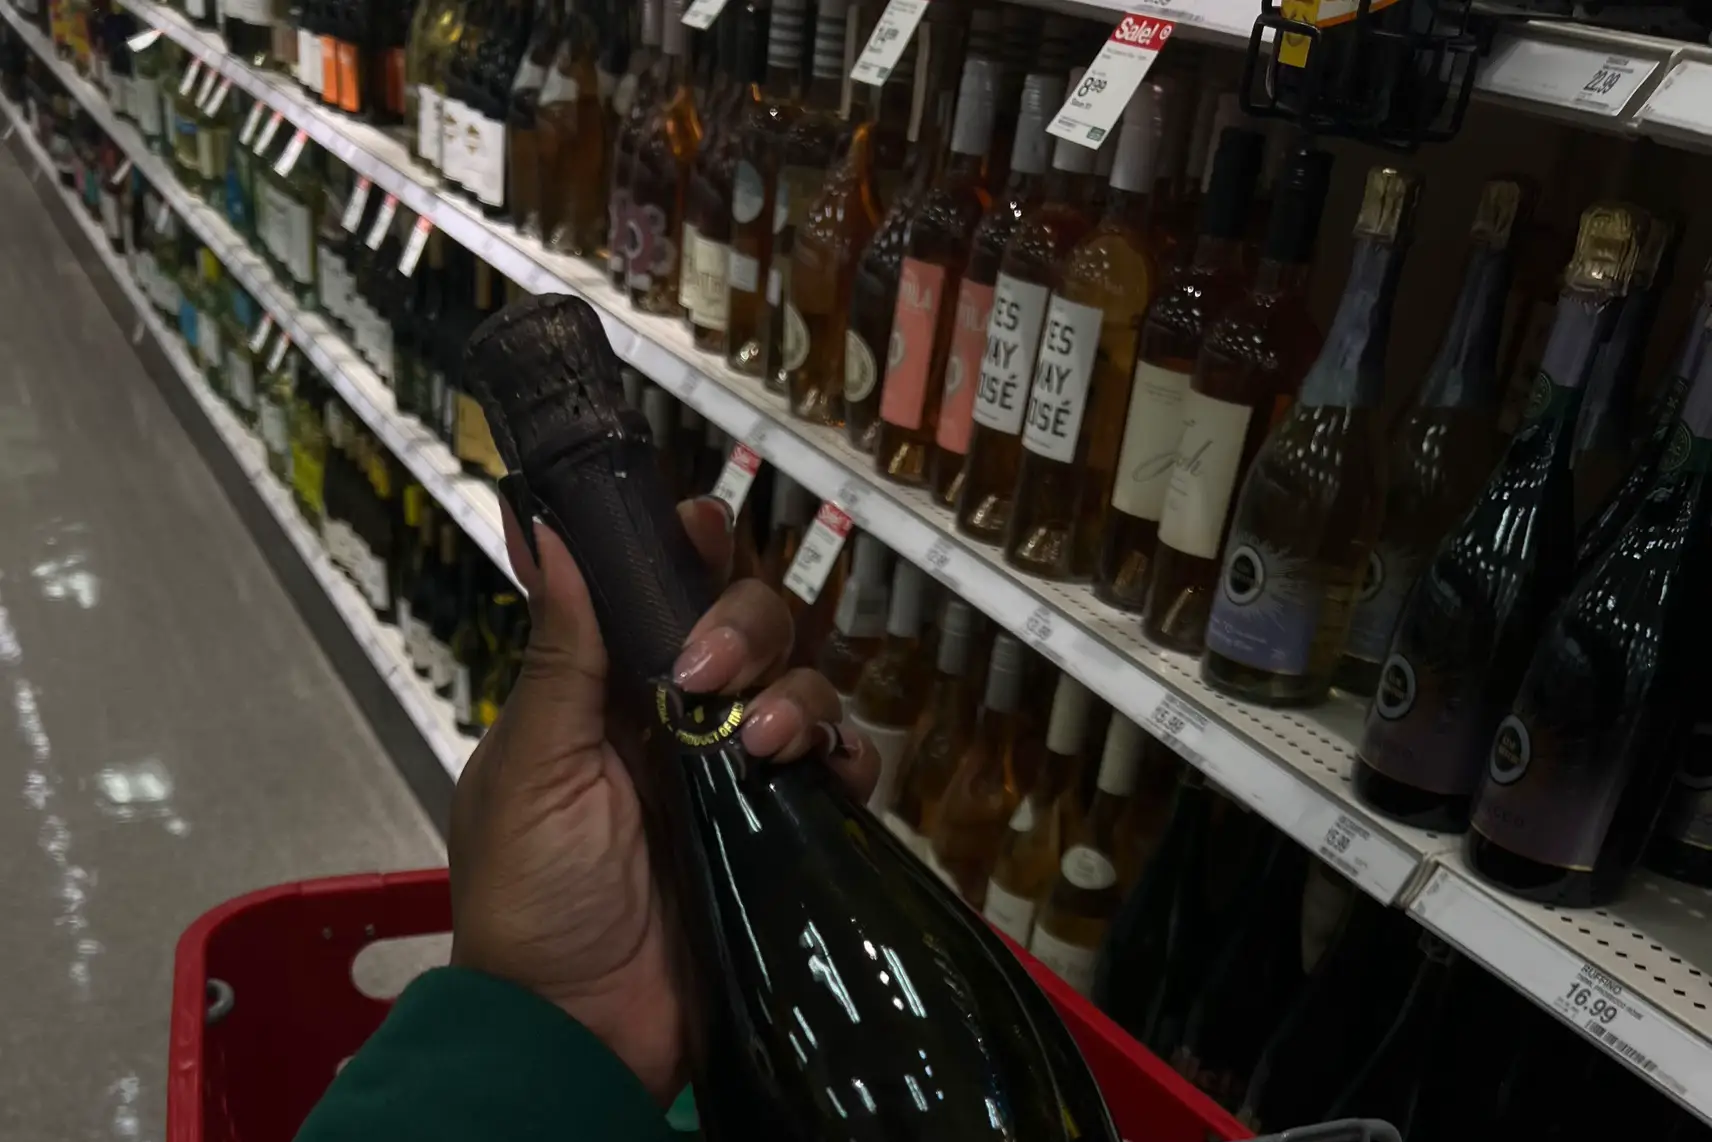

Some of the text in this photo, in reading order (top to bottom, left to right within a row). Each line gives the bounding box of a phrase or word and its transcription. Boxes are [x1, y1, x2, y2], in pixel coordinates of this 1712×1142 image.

[1114, 17, 1160, 46] Sale!
[1583, 70, 1621, 95] 22.99
[994, 297, 1022, 332] ES
[1046, 319, 1075, 356] ES
[1580, 963, 1623, 996] RUFFINO
[1566, 982, 1618, 1024] 16.99
